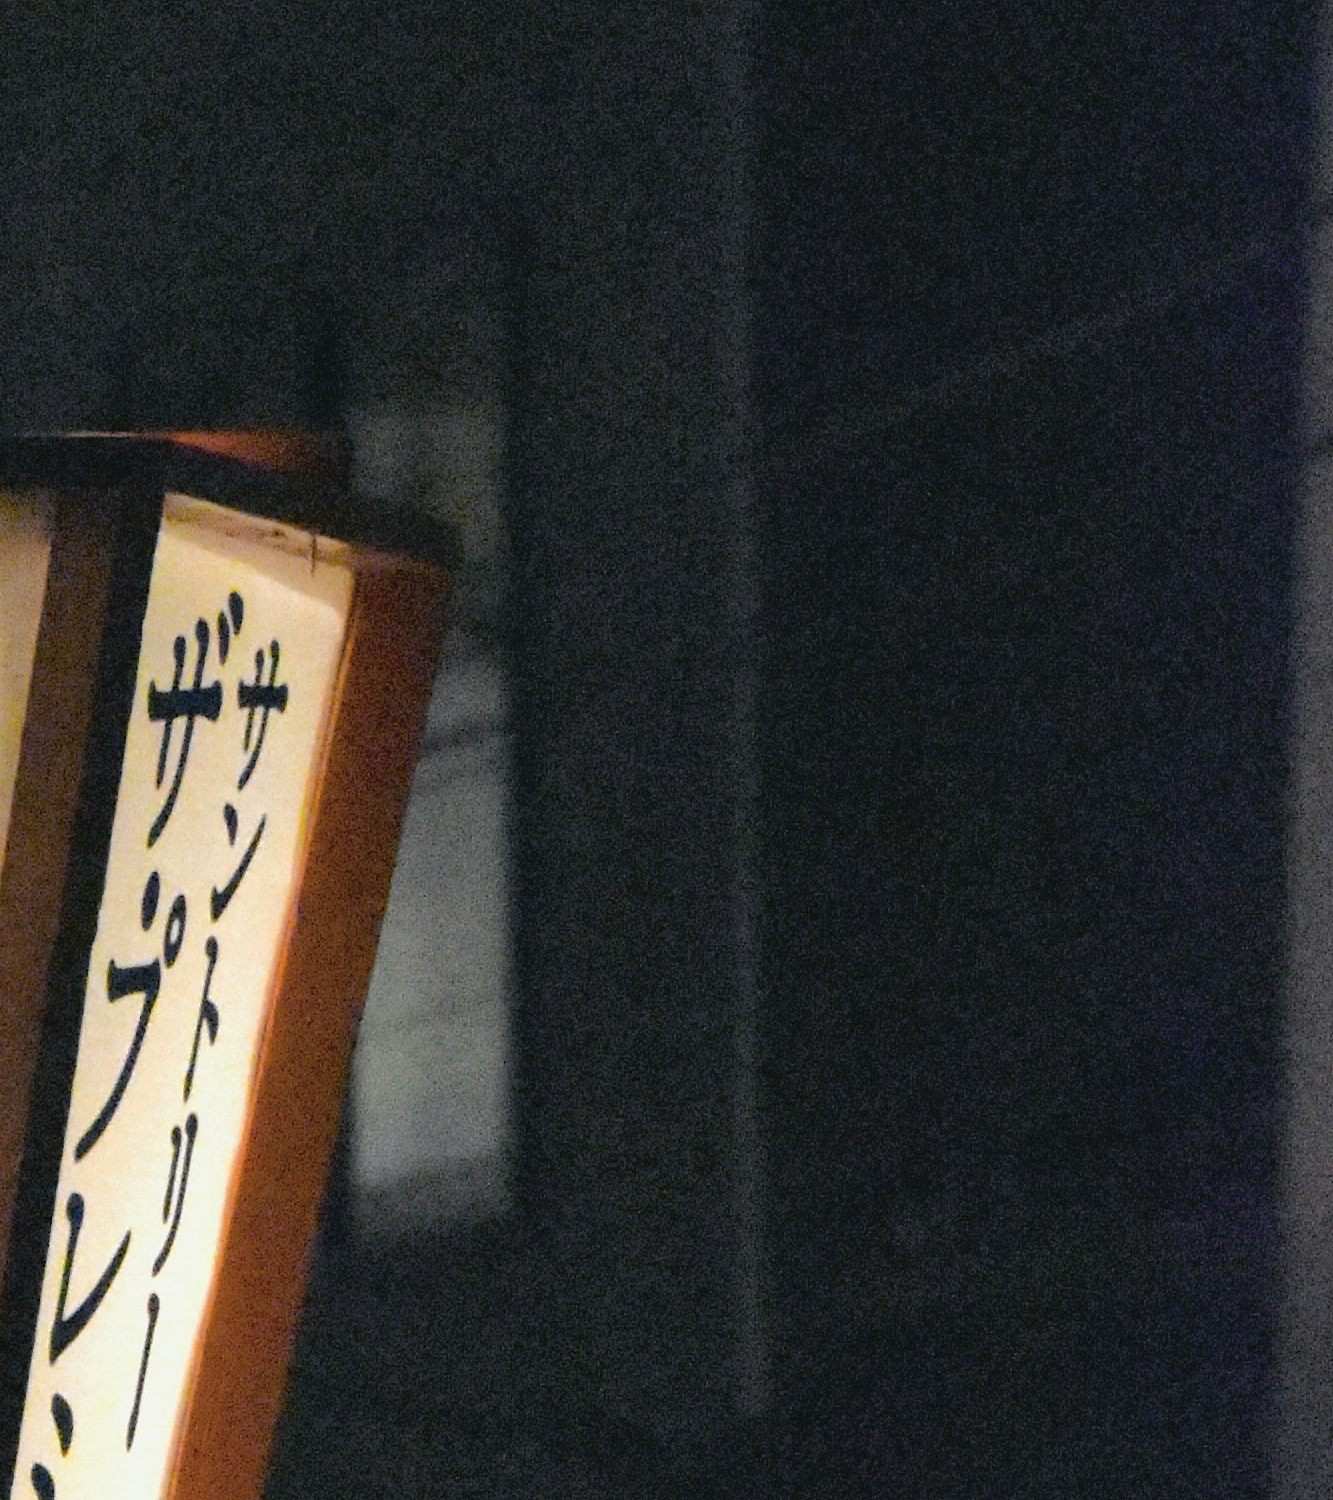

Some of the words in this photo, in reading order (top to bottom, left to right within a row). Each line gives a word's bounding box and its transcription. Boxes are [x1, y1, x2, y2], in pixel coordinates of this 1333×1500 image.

[128, 640, 289, 1452] サントリー
